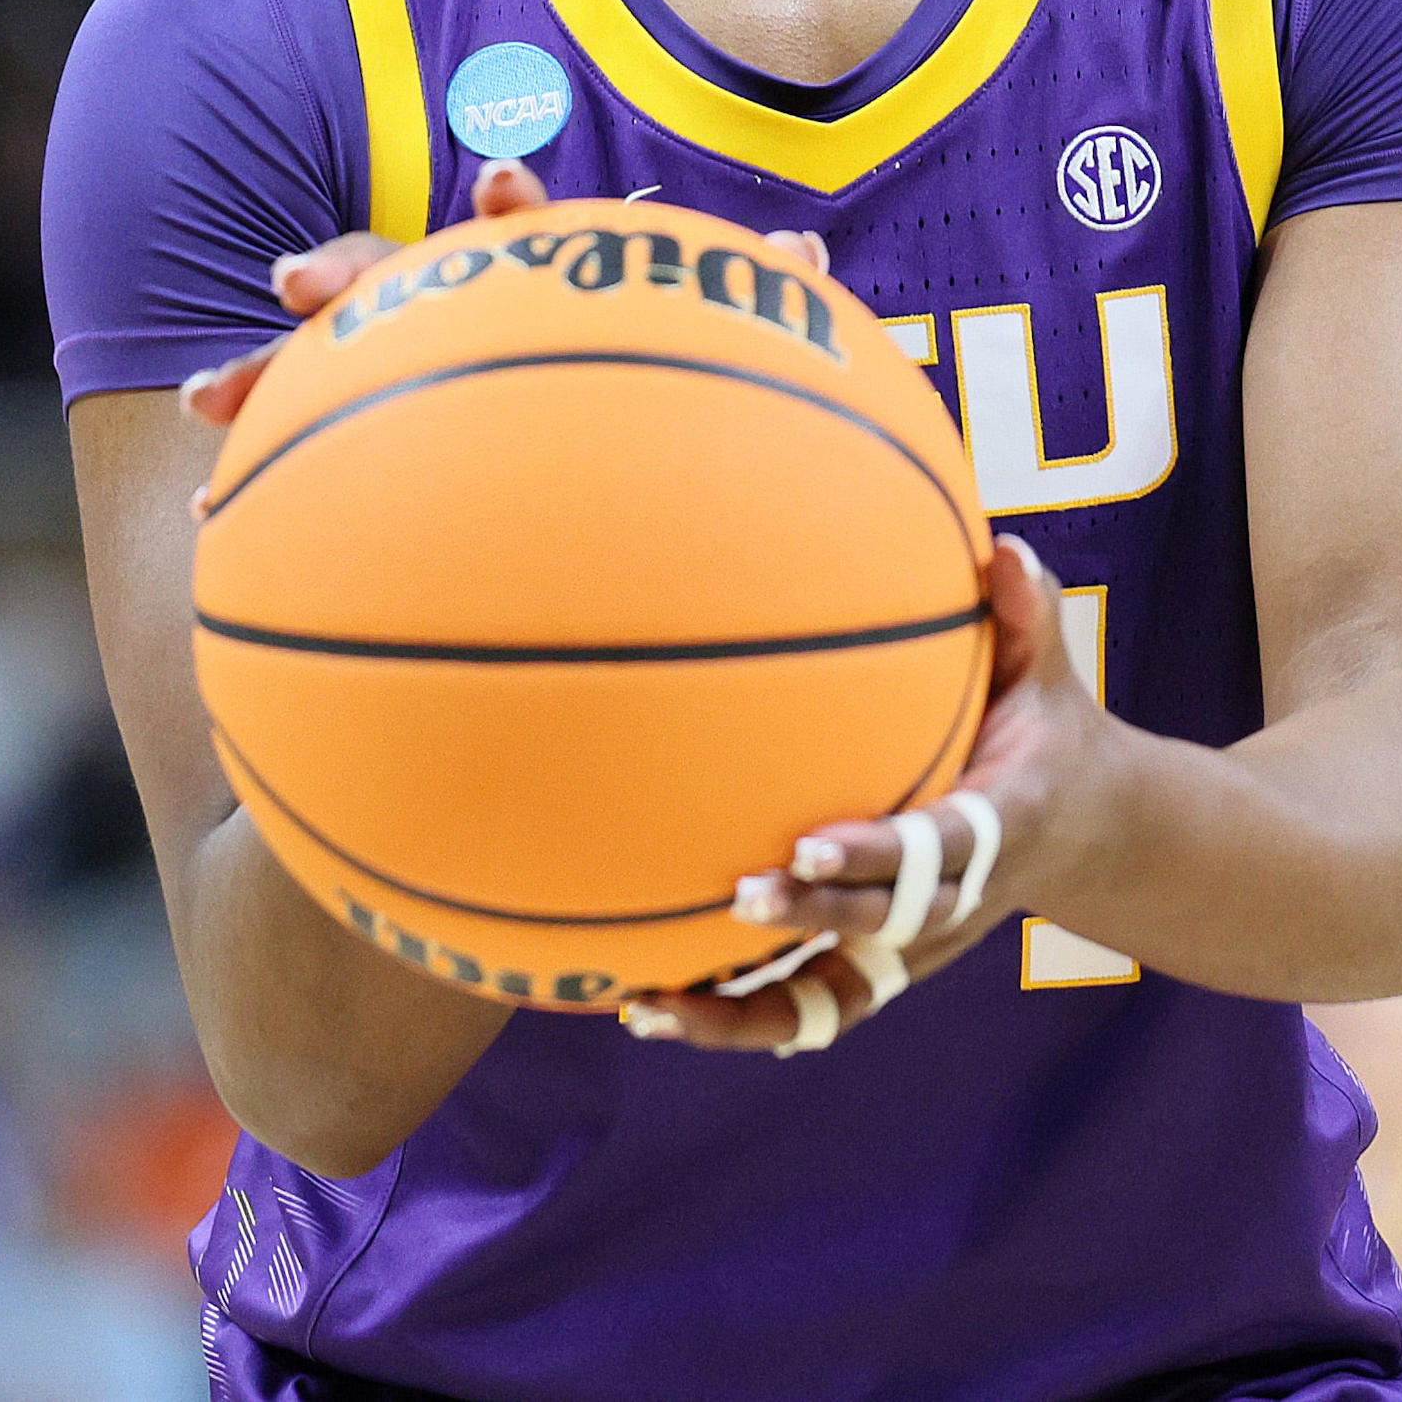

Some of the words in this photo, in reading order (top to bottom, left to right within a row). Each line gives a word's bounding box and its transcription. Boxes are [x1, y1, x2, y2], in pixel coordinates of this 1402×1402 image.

[464, 90, 565, 134] NCAA
[1066, 135, 1151, 221] SEC
[333, 229, 847, 364] Wilson
